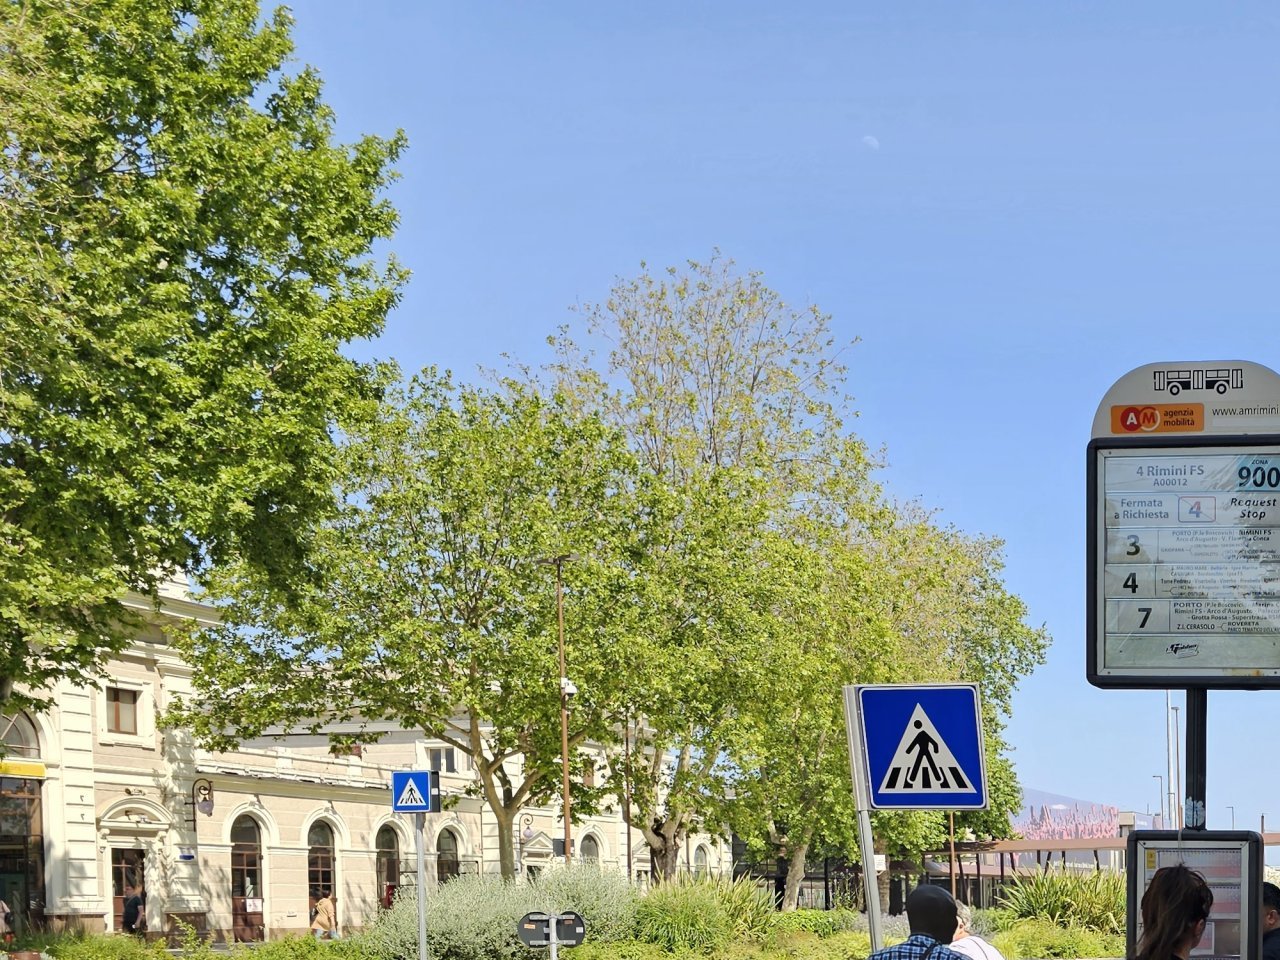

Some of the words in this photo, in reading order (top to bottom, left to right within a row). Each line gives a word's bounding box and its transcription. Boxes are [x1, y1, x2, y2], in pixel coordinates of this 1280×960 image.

[1163, 408, 1194, 417] agenzia
[1163, 418, 1195, 426] mobilità
[1136, 466, 1143, 477] 4
[1147, 465, 1187, 477] Rimini
[1190, 465, 1204, 476] FS
[1238, 466, 1280, 488] 900
[1153, 478, 1188, 487] A00012
[1121, 498, 1163, 508] Fermata
[1231, 497, 1277, 509] Request
[1114, 512, 1119, 520] a
[1122, 509, 1169, 519] Richiesta
[1240, 509, 1266, 521] Stop
[1126, 534, 1141, 556] 3
[1122, 572, 1139, 594] 4
[1137, 607, 1153, 629] 7
